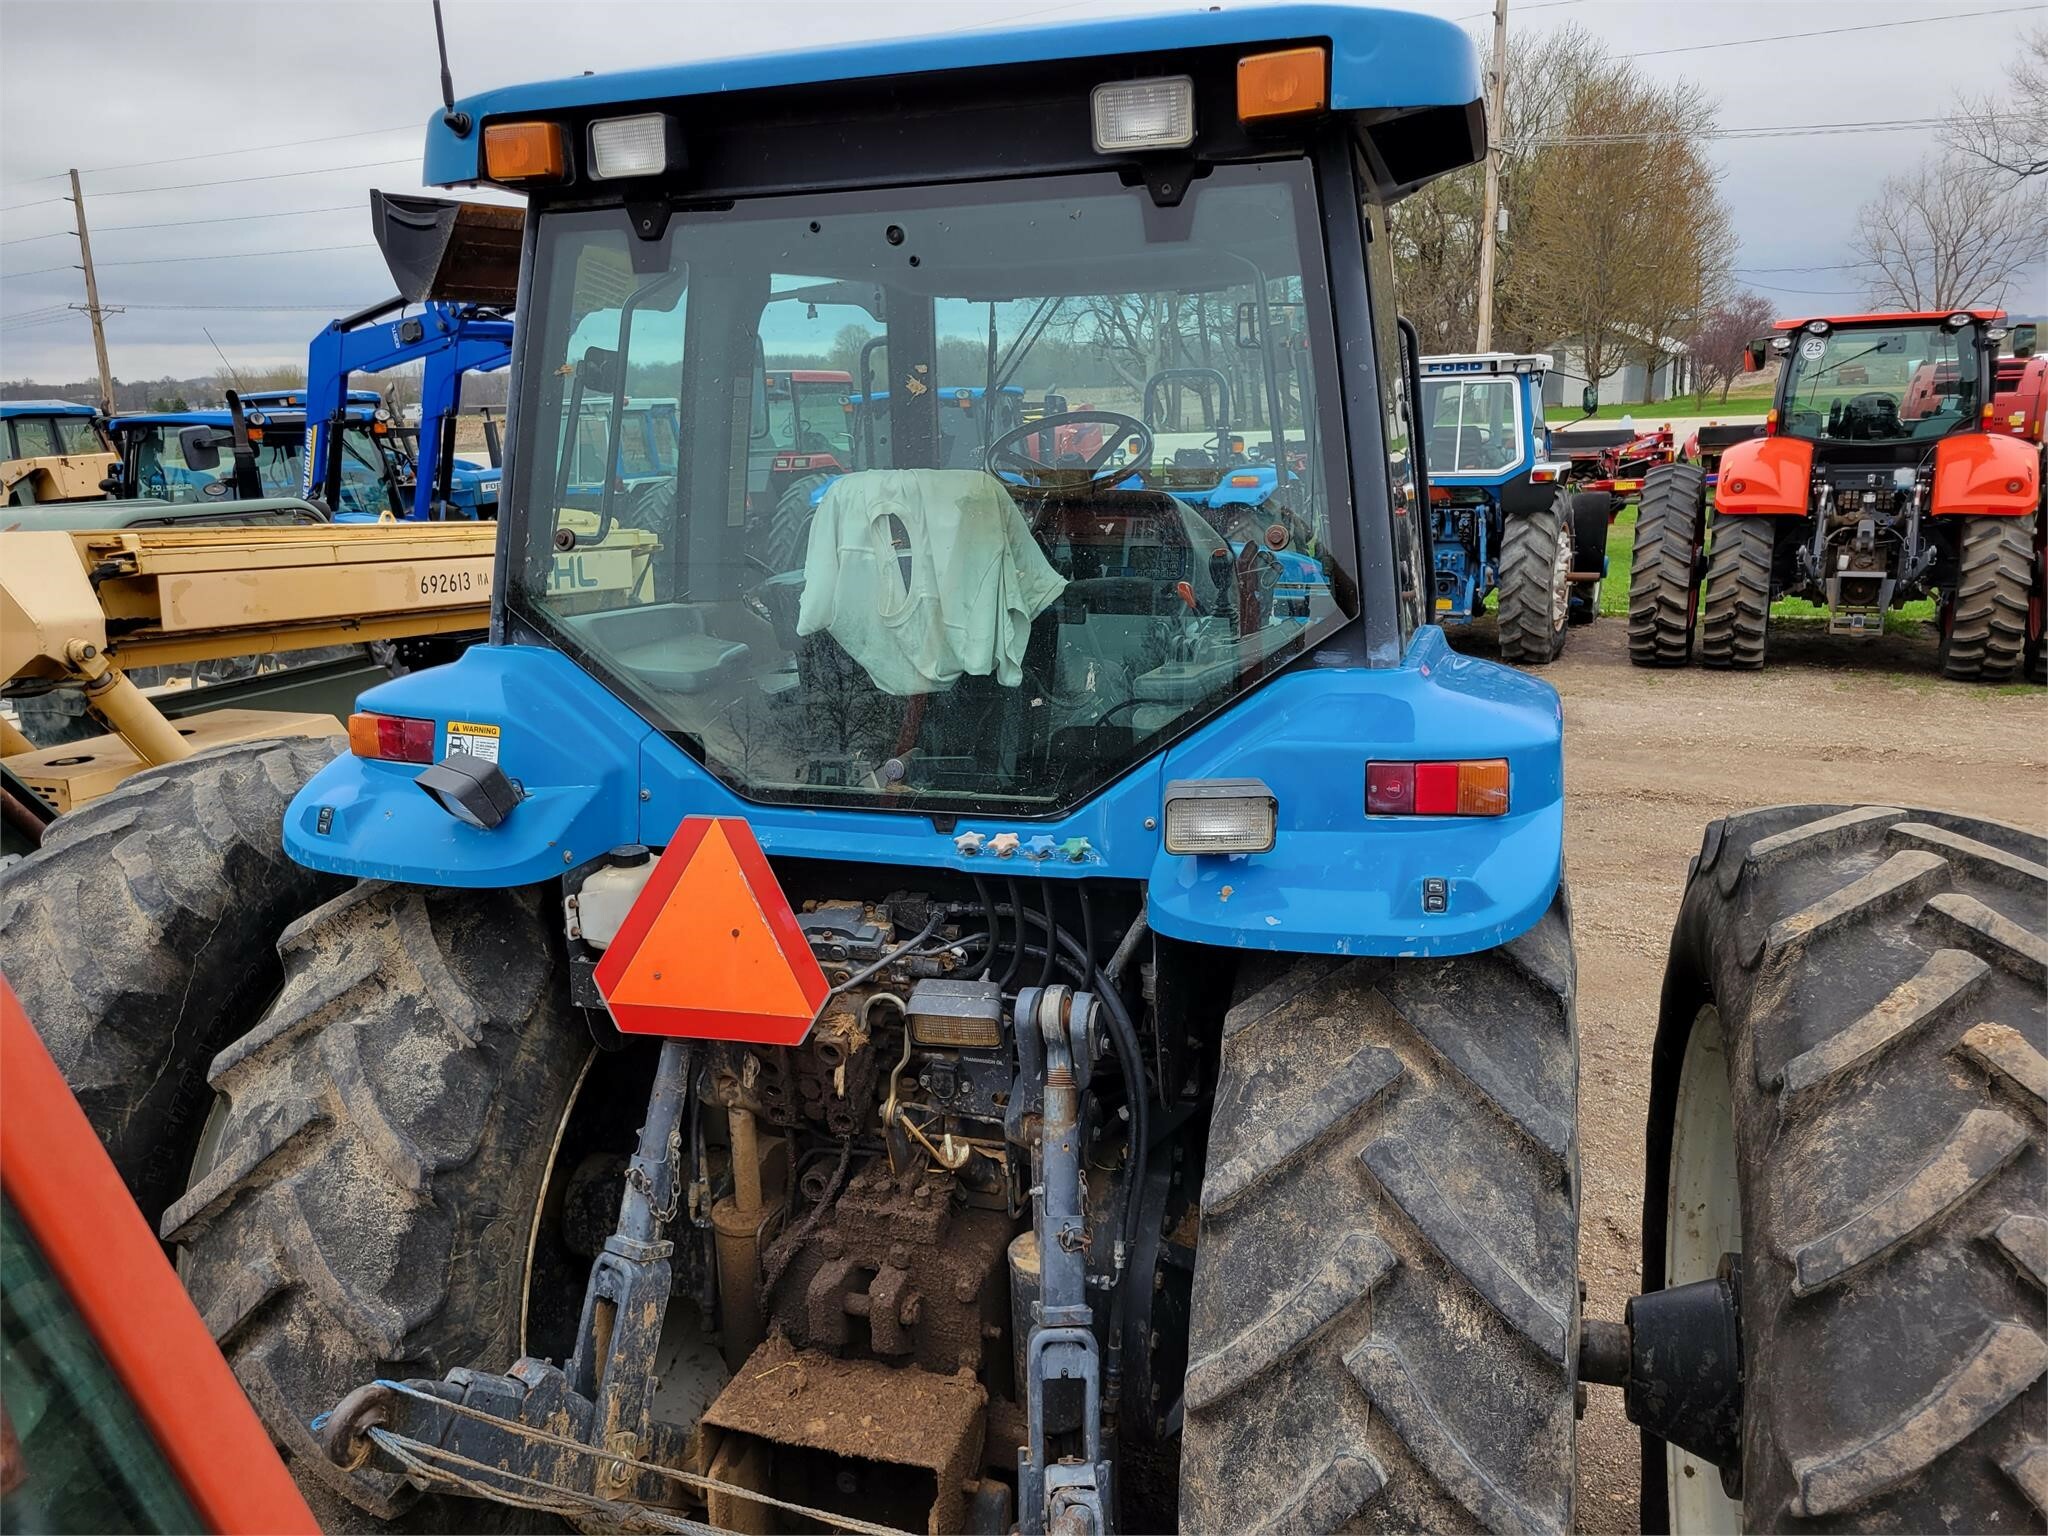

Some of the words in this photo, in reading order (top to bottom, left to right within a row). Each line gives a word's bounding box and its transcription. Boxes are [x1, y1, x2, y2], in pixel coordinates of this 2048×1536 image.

[1806, 341, 1822, 352] 25
[1428, 361, 1483, 373] FORD
[304, 427, 313, 475] HOLLAND
[302, 475, 310, 500] NEW
[421, 571, 471, 594] 692613
[462, 724, 497, 735] WARNING
[963, 1055, 995, 1065] TRANSMISSION
